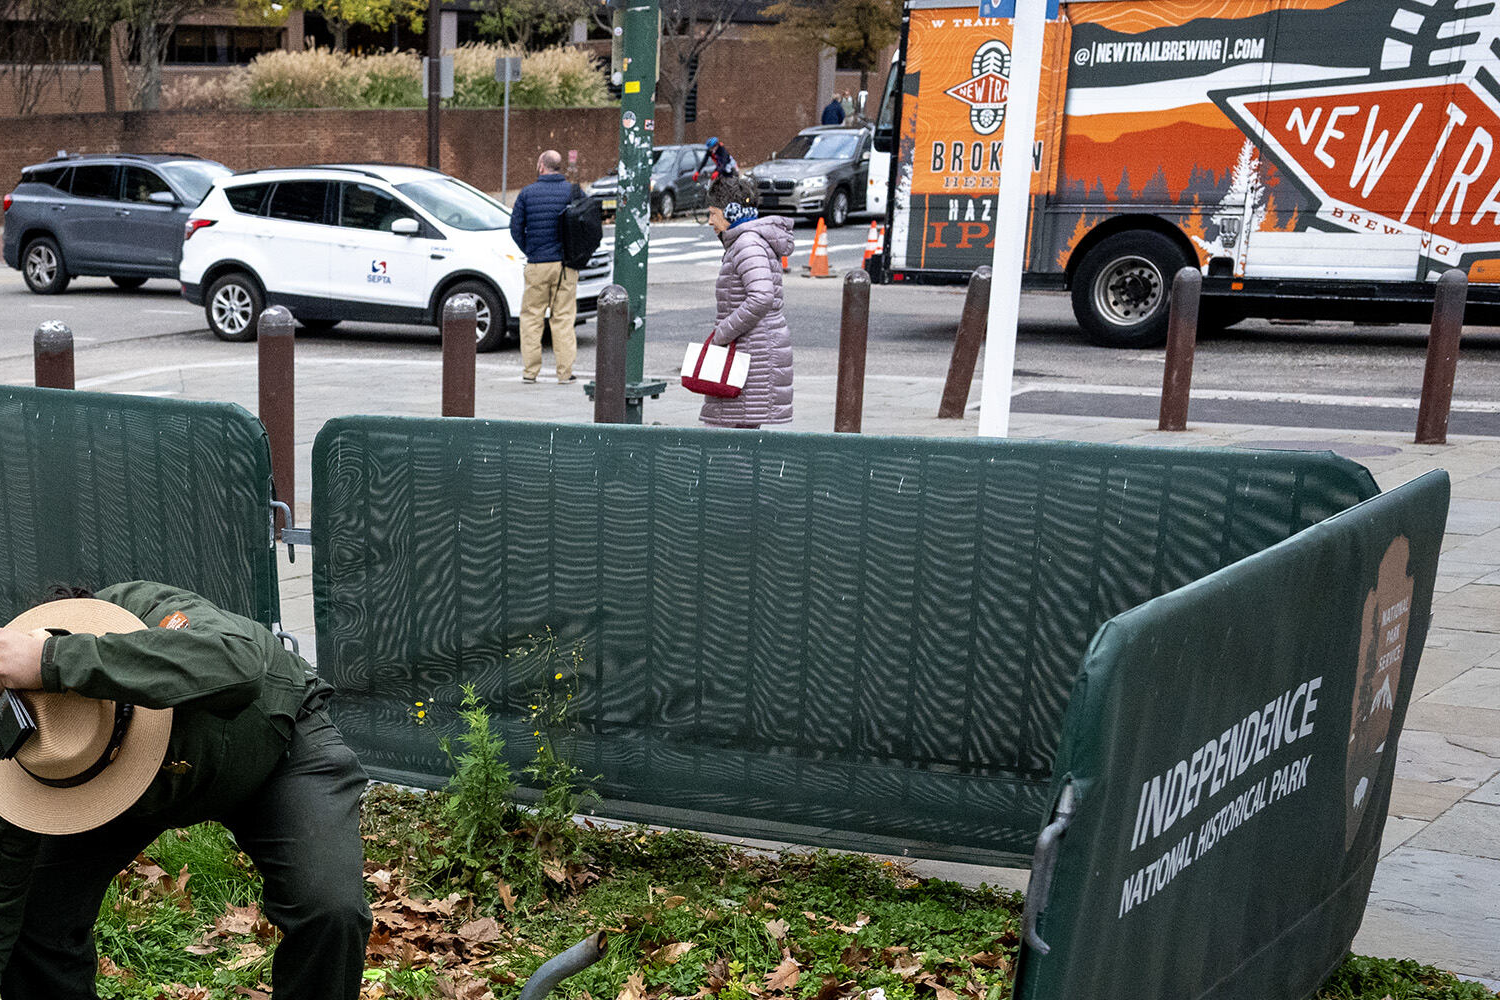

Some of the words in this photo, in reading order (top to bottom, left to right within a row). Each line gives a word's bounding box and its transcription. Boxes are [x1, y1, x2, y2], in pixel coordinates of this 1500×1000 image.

[959, 79, 986, 102] NEW
[988, 77, 1009, 103] TRA
[930, 140, 1044, 173] BROKN
[1285, 102, 1424, 199] NEW
[1400, 102, 1500, 226] TRA
[943, 175, 1001, 189] HEE
[948, 198, 992, 221] HAZ
[1331, 206, 1451, 256] BREWNG
[367, 274, 391, 284] SEPTA
[1381, 596, 1409, 627] NATIONAL
[1386, 622, 1401, 647] PARK
[1378, 644, 1402, 673] SERVICE
[1130, 676, 1323, 851] INDEPENDENCE
[1118, 831, 1193, 919] NATIONAL
[1195, 775, 1267, 861] HISTORICAL
[1268, 753, 1313, 806] PARK
